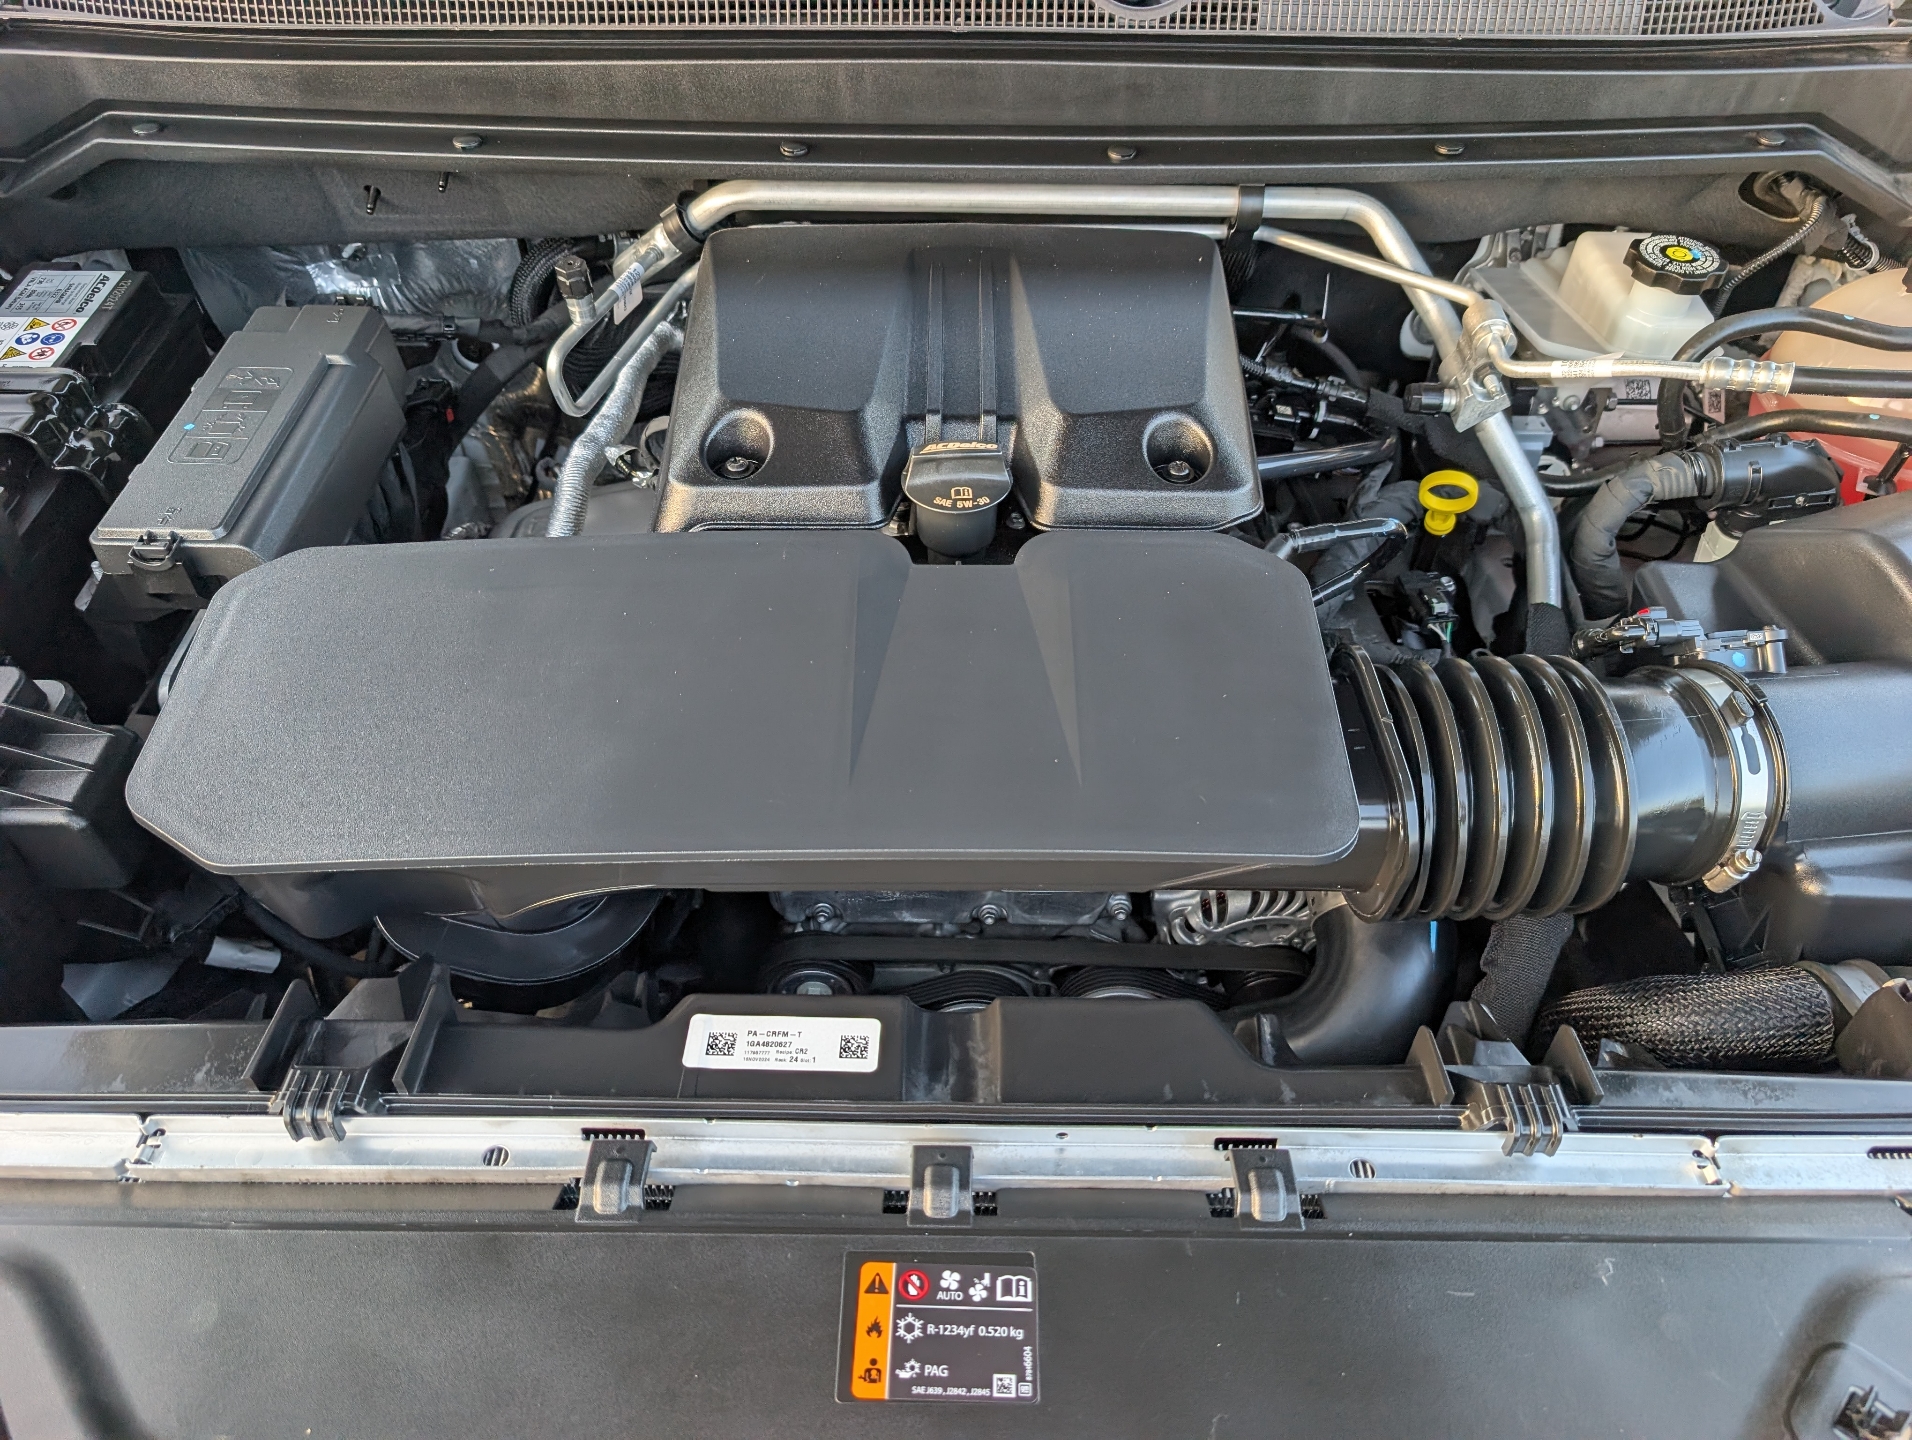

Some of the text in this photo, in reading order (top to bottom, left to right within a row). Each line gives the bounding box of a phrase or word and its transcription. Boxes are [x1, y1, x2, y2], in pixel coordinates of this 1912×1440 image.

[76, 274, 110, 314] ACDelco
[925, 441, 998, 452] ACDelco
[933, 496, 990, 508] SAE 5W-30
[795, 1047, 808, 1055] CR2
[789, 1055, 798, 1063] 24
[936, 1291, 963, 1301] AUTO
[927, 1324, 1024, 1340] R-1234yf 0.520 kg
[924, 1364, 949, 1377] PAG
[911, 1385, 926, 1394] SAE
[969, 1387, 991, 1397] J2845
